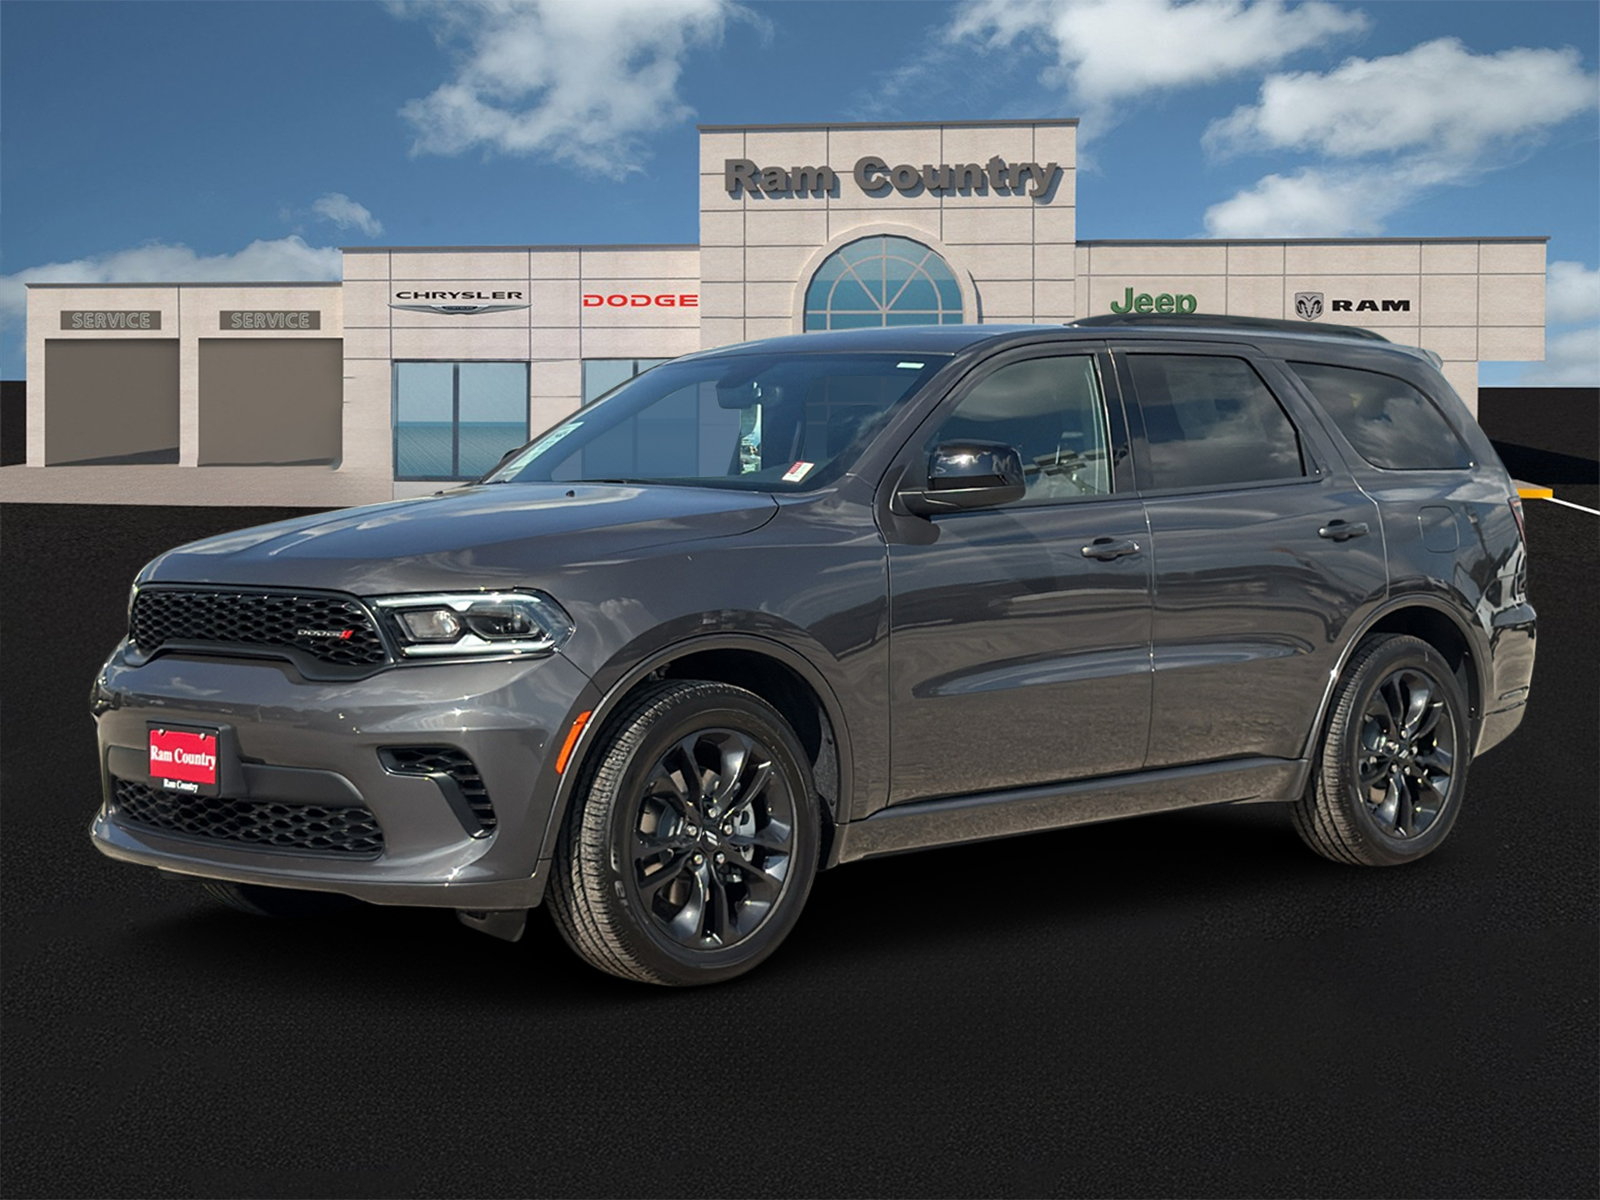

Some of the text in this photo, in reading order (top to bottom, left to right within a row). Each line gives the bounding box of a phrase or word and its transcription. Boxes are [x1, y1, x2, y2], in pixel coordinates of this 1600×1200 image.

[724, 154, 1058, 197] Ram Country
[395, 291, 523, 300] CHRYSLER
[583, 294, 699, 307] DODGE
[1110, 287, 1198, 314] Jeep
[1331, 299, 1411, 312] RAM
[71, 312, 151, 329] SERVICE
[230, 312, 311, 329] SERVICE
[150, 745, 216, 771] Ram Country
[163, 778, 199, 793] Ram Country
